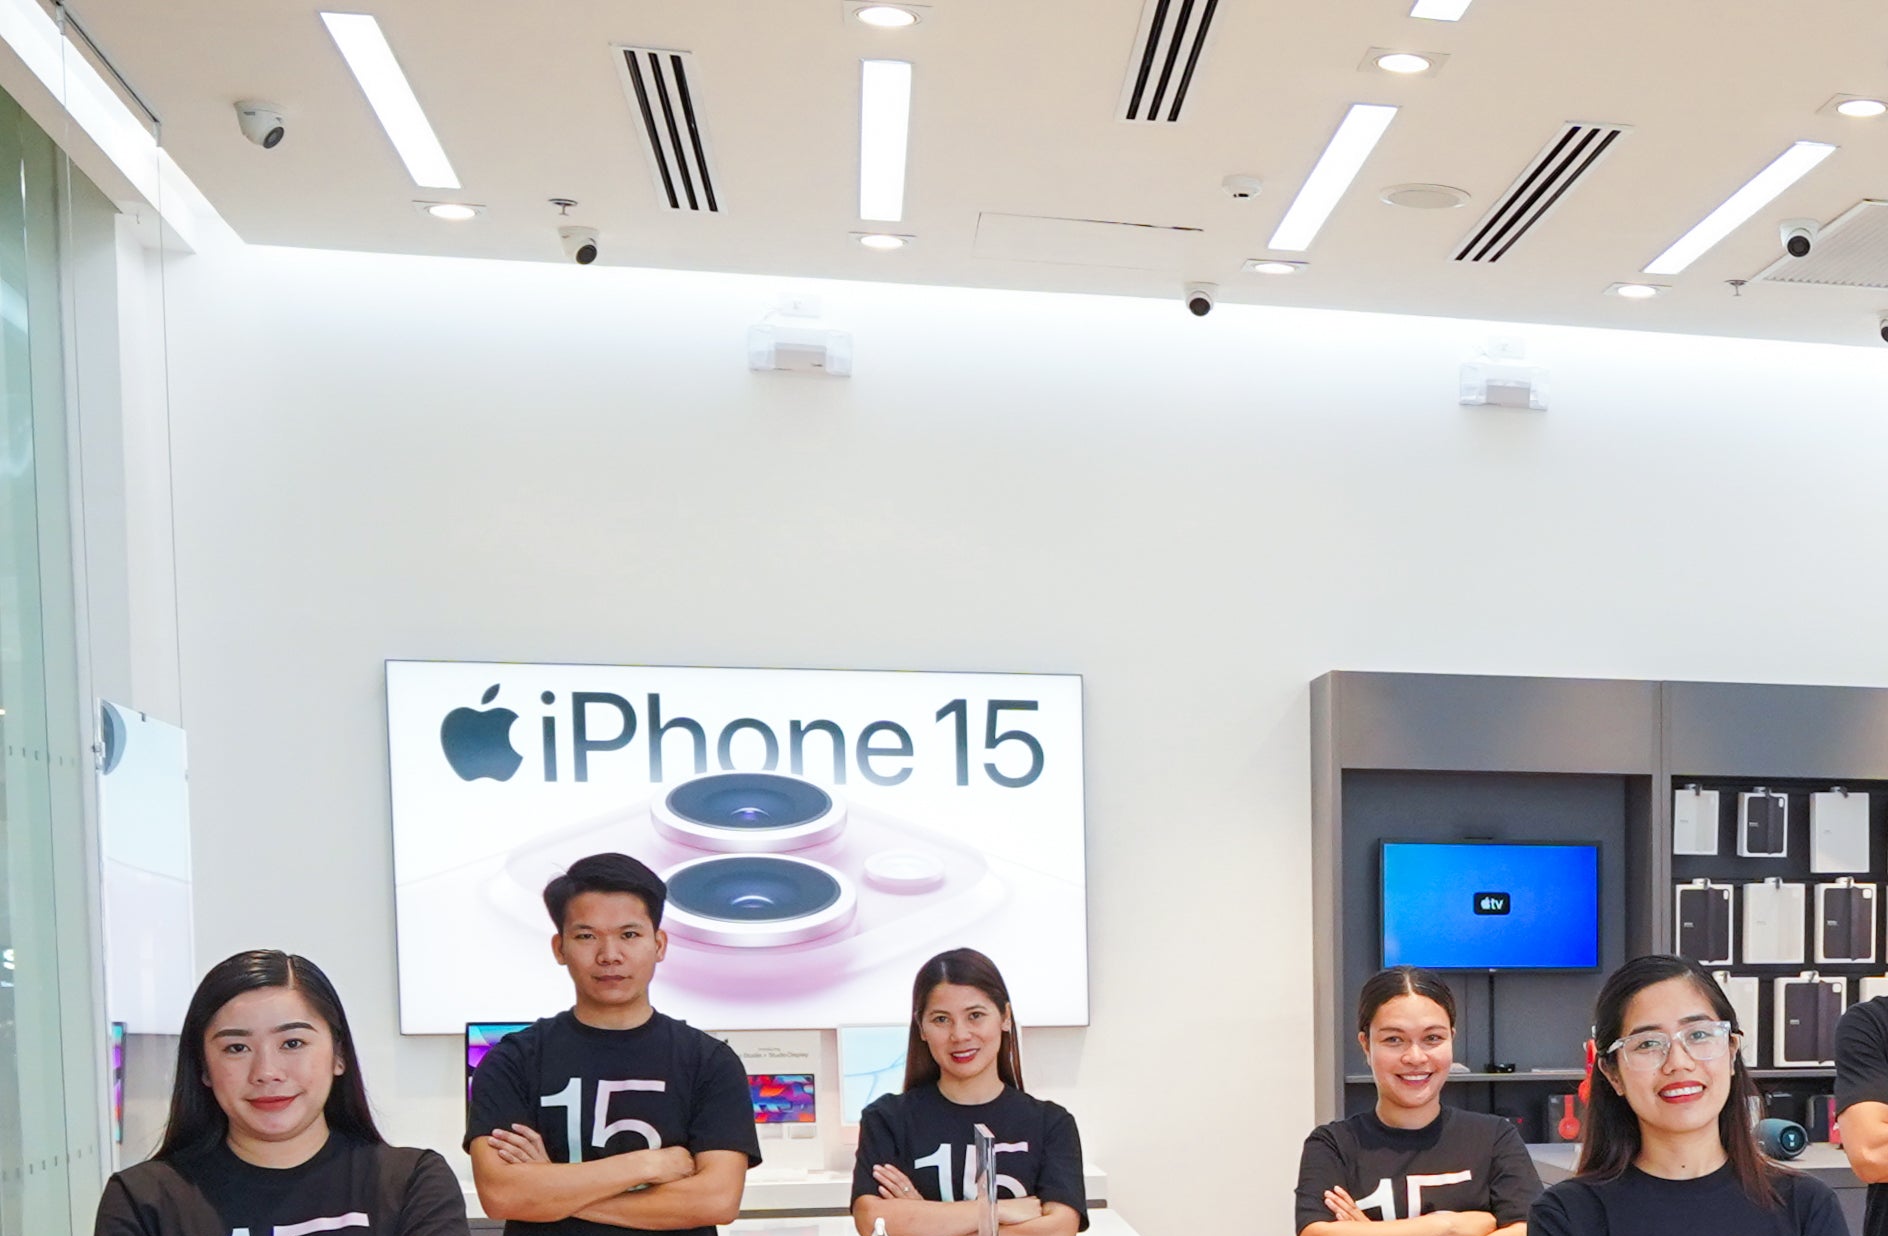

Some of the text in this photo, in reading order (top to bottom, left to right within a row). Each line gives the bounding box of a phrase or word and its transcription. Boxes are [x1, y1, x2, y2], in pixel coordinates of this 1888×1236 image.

[540, 690, 1045, 789] iPhone 15
[1490, 898, 1504, 910] tv
[540, 1077, 666, 1164] 15
